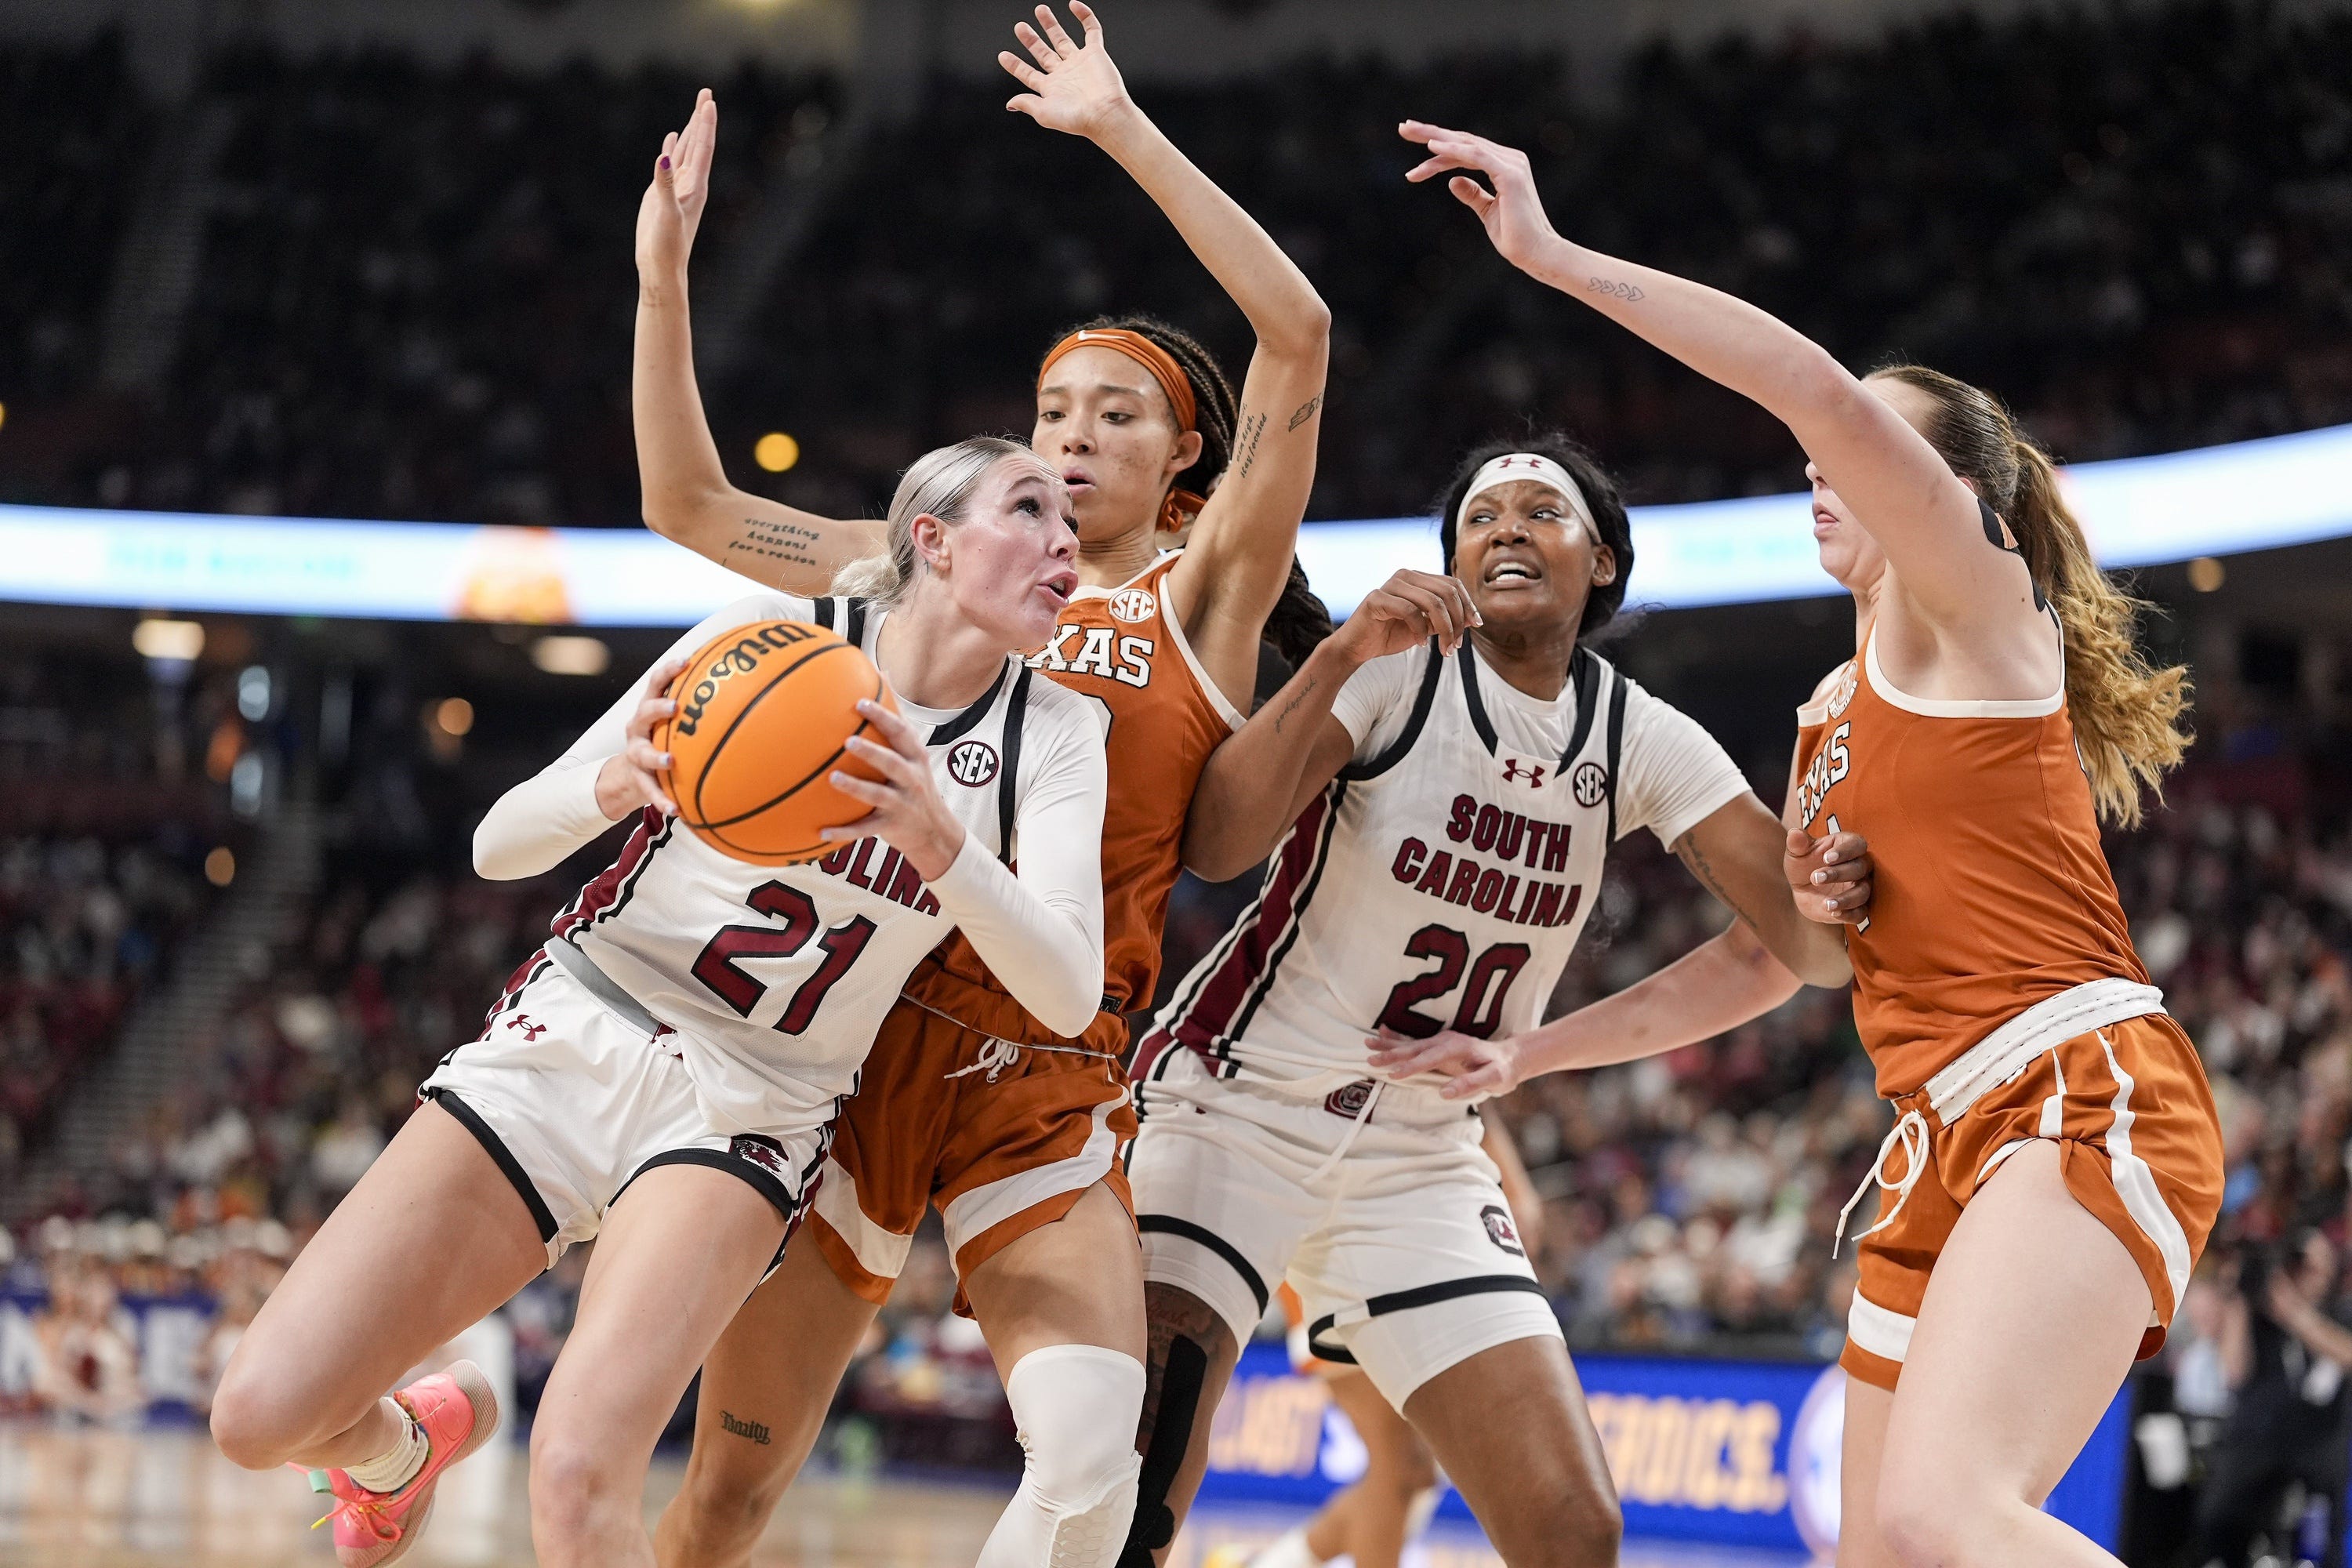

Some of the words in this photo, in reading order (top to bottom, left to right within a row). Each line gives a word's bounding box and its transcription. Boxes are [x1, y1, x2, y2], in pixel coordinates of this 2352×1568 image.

[728, 541, 753, 551] for
[768, 550, 817, 565] reason
[744, 517, 821, 541] everything
[747, 531, 808, 550] happens
[1112, 590, 1153, 622] SEC
[677, 623, 818, 736] Wilson
[1015, 623, 1155, 689] XAS
[951, 742, 995, 786] SEC
[1575, 765, 1607, 804] SEC
[1796, 720, 1851, 829] EXAS
[1446, 793, 1572, 873] SOUTH
[1391, 837, 1582, 928] CAROLINA
[690, 878, 878, 1036] 21
[1372, 923, 1532, 1039] 20
